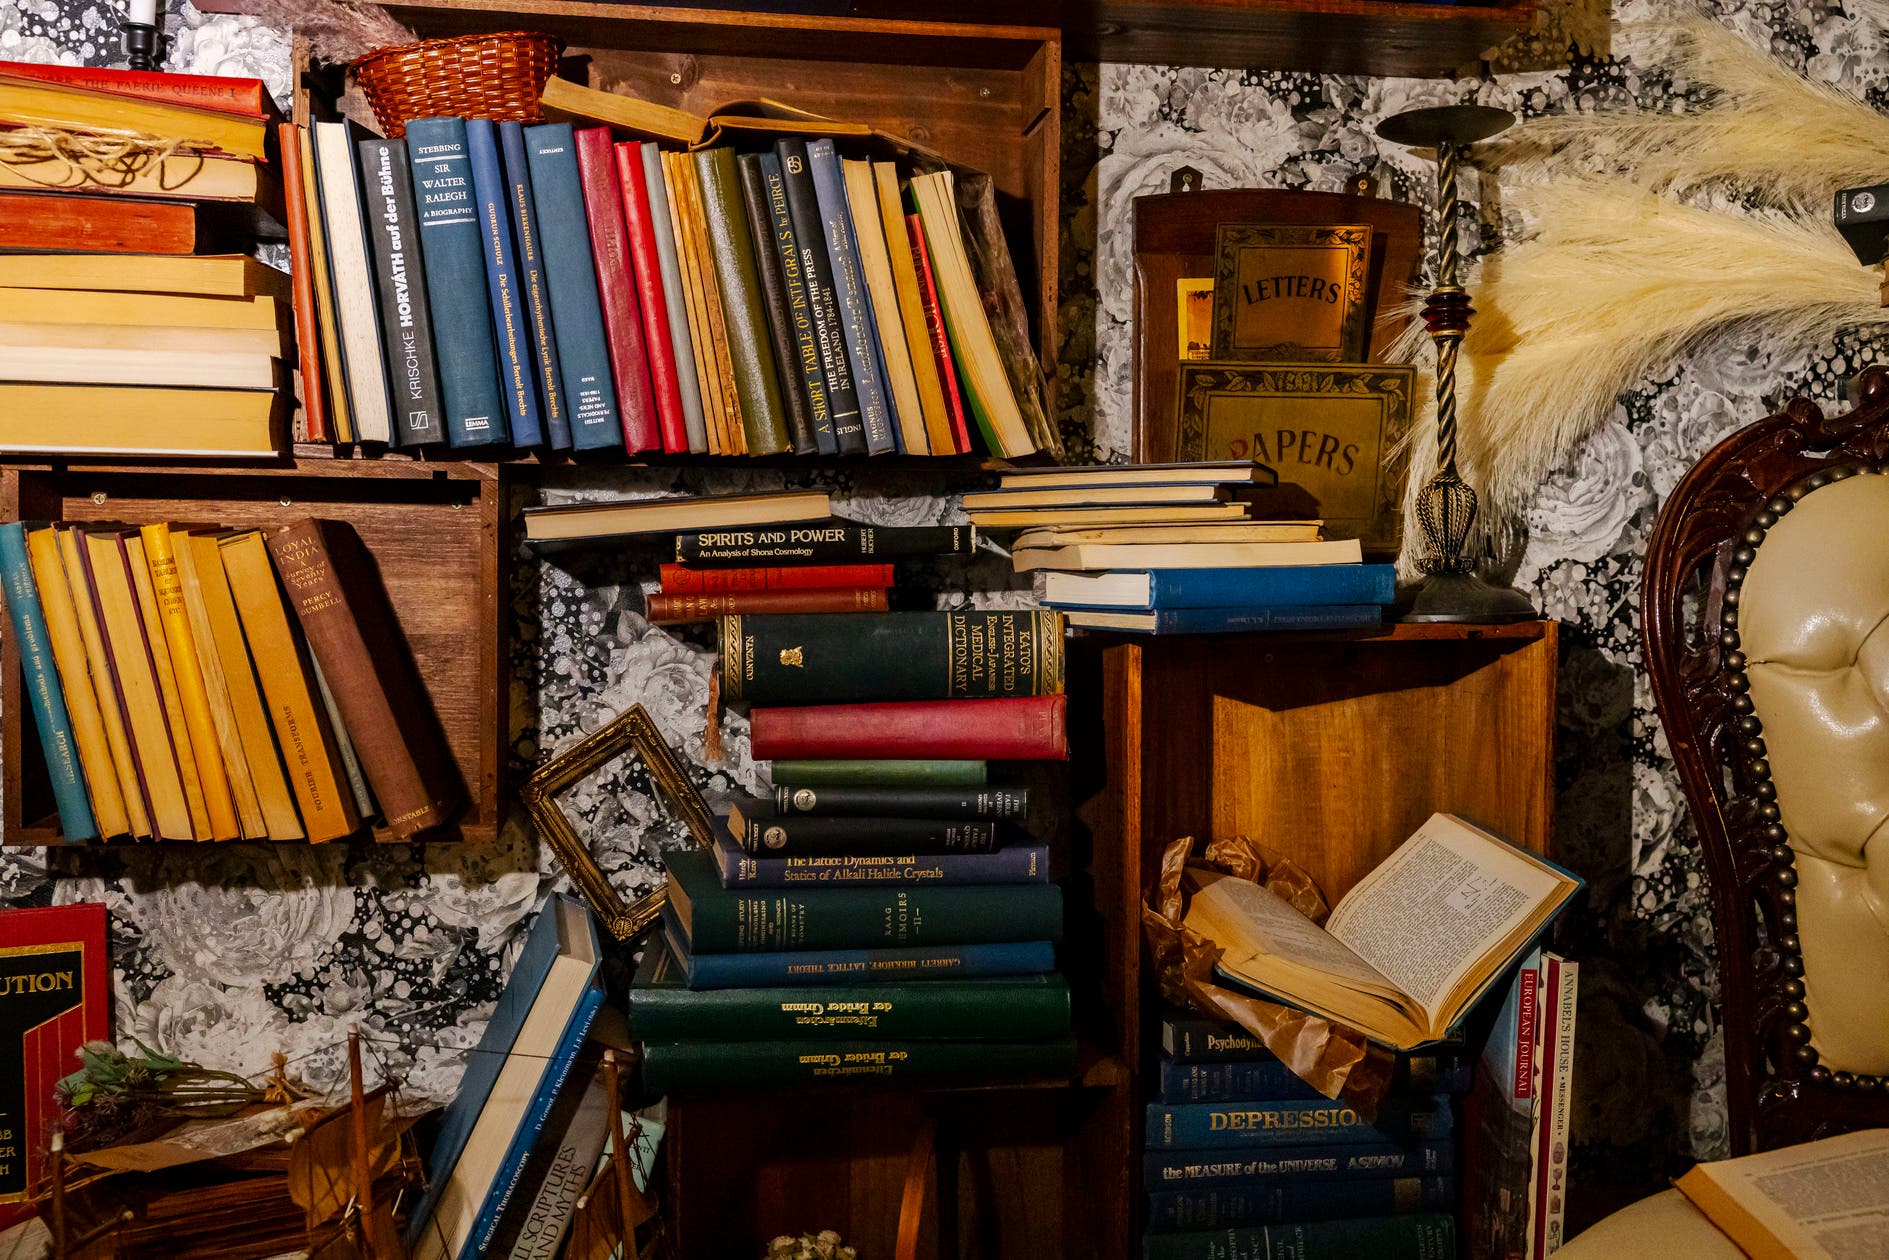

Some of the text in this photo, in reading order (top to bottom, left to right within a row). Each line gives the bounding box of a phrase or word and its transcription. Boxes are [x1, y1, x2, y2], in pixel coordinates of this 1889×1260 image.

[84, 78, 109, 89] THE
[171, 85, 224, 97] QUEENE
[418, 143, 461, 154] STEBBING
[434, 164, 451, 173] SIR
[422, 178, 466, 189] WALTER
[517, 184, 526, 207] KLAUS
[768, 173, 787, 215] PEIRCE
[425, 192, 467, 204] RALEGH
[430, 207, 472, 217] BIOGRAPHY
[488, 202, 499, 235] GUDRUN
[493, 237, 503, 265] SCHULZ
[378, 146, 422, 399] KRISCHKE HORVÁTH auf der Bühne
[499, 274, 507, 287] Die
[530, 269, 538, 283] Die
[780, 230, 806, 310] INTEGRALS
[1242, 275, 1341, 305] LETTERS
[794, 311, 809, 329] OF
[802, 249, 839, 393] THE FREEDOM OF THE PRESS
[822, 287, 850, 390] IN IRELAND, 1784-1841
[541, 347, 551, 365] Lyrik
[799, 331, 818, 374] TABLE
[513, 365, 524, 390] Bertolt
[544, 366, 555, 391] Bertolt
[516, 390, 526, 416] Brechts
[548, 391, 558, 418] Brechts
[808, 381, 828, 421] SHORT
[818, 424, 830, 434] A
[837, 424, 862, 436] INGLIS
[866, 406, 878, 441] MAGNUS
[698, 529, 846, 547] SPIRITS AND POWER
[279, 546, 319, 565] INDIA
[699, 547, 814, 559] An Analysis of Shona Cosmology
[302, 591, 332, 606] PERCY
[24, 614, 40, 652] problems
[745, 635, 754, 681] NANZANDO
[954, 615, 967, 692] DICTIONARY
[971, 625, 984, 681] MEDICAL
[1002, 614, 1015, 691] INTEGRATED
[1019, 631, 1031, 675] KATO'S
[283, 705, 309, 767] TRANSFORMS
[305, 770, 323, 811] FOURIER
[738, 858, 748, 880] Hardy
[784, 866, 944, 882] Statics of Alkali Halide Crystals
[786, 856, 806, 867] The
[844, 856, 894, 869] Dynamics
[897, 854, 915, 865] and
[787, 964, 824, 974] THEORY
[828, 962, 865, 973] LATTICE
[921, 958, 961, 968] GARRETT
[781, 1002, 893, 1015] der Brüder Grimm
[1519, 973, 1534, 1036] EUROPEAN
[799, 1051, 908, 1067] der Brüder Grimm
[1556, 970, 1575, 1131] ANNABEL'S HOUSE MESSENGER
[1517, 1038, 1531, 1093] JOURNAL
[1209, 1107, 1361, 1131] DEPRESSIO
[1162, 1155, 1405, 1180] the MEASURE of the UNIVERSE ASIMOV
[478, 1150, 532, 1252] SURGICAL THORACOSCOPY
[523, 1145, 577, 1243] SCRIPTURES
[556, 1164, 587, 1223] MYTHS
